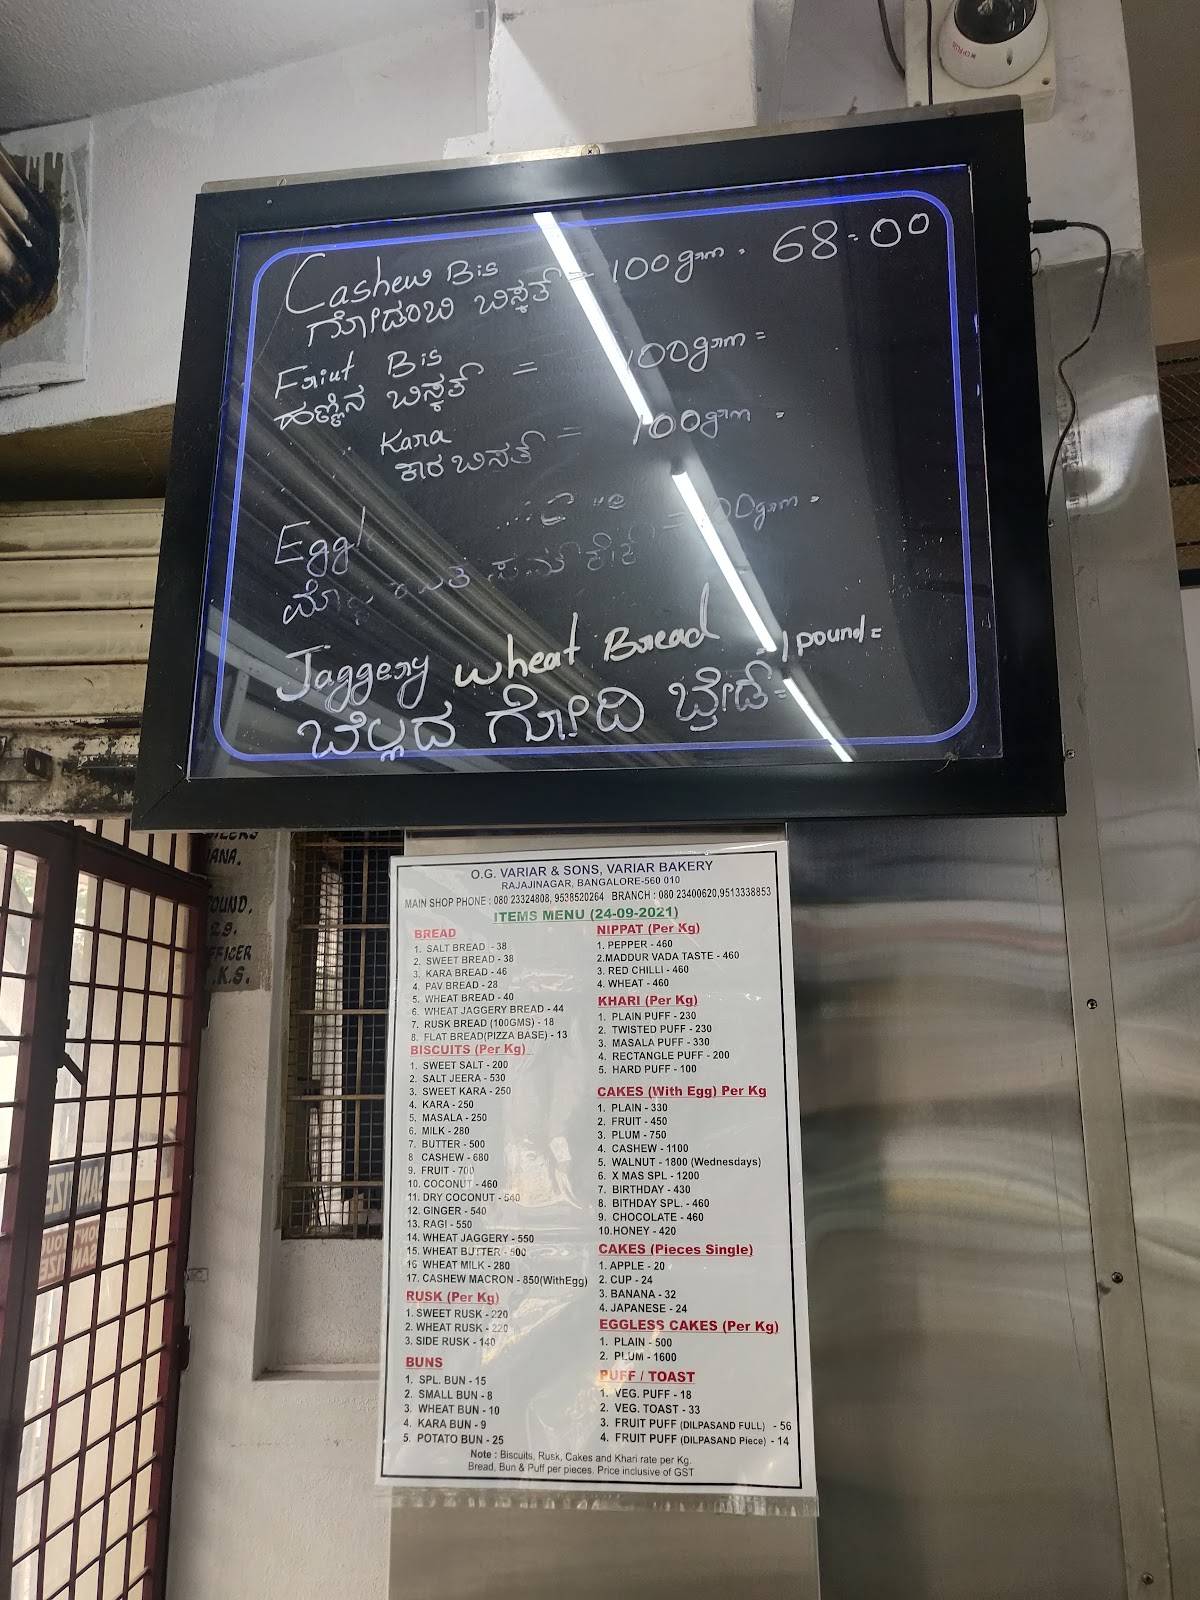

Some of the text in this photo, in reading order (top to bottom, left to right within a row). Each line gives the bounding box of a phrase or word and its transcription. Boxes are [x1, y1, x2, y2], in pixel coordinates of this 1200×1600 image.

[285, 253, 432, 314] Cashew
[447, 260, 498, 285] Bis
[387, 349, 442, 378] Bis
[380, 429, 452, 455] Kara
[604, 583, 720, 662] Bread
[207, 848, 241, 865] ANA.
[471, 861, 713, 880] O.G. VARIAR & SONS, VARIAR BAKERY
[501, 876, 680, 890] RAJAJINAGAR, BANGALORE-560 010
[405, 899, 427, 908] MAIN
[430, 898, 453, 907] SHOP
[456, 897, 487, 906] PHONE
[494, 896, 508, 905] 080
[511, 894, 551, 904] 23324808,
[555, 892, 604, 903] 9538520264
[612, 891, 651, 900] BRANCH
[658, 890, 674, 899] 080
[494, 907, 678, 922] ITEMS MENU (24-09-2021)
[414, 929, 456, 939] BREAD
[597, 923, 700, 935] NIPPAT (Per Kg)
[427, 942, 507, 953] SALT BREAD 38
[608, 941, 648, 949] PEPPER
[426, 955, 514, 965] SWEET BREAD 38
[426, 968, 507, 978] KARA BREAD 46
[608, 966, 628, 975] RED
[632, 966, 664, 974] CHILLI
[425, 982, 443, 990] PAV
[446, 981, 478, 989] BREAD
[425, 993, 514, 1003] WHEAT BREAD 40
[598, 995, 697, 1007] KHARI (Per Kg)
[425, 1007, 458, 1016] WHEAT
[460, 1006, 507, 1015] JAGGERY
[510, 1005, 544, 1013] BREAD
[612, 1025, 656, 1034] TWISTED
[660, 1025, 686, 1033] PUFF
[410, 1044, 526, 1055] BISCUITS (Per Kg)
[422, 1061, 508, 1070] SWEET SALT 200
[422, 1074, 506, 1083] SALT JEERA 530
[598, 1085, 767, 1098] CAKES (With Egg) Per Kg
[611, 1103, 668, 1112] PLAIN 330
[422, 1113, 487, 1122] MASALA 250
[422, 1127, 470, 1135] MILK 280
[422, 1140, 485, 1148] BUTTER 500
[422, 1153, 489, 1162] CASHEW 680
[612, 1156, 762, 1168] WALNUT 1800 (Wednesdays)
[612, 1185, 691, 1194] BIRTHDAY 430
[612, 1213, 704, 1221] CHOCOLATE 460
[423, 1234, 534, 1243] WHEAT JAGGERY 550
[599, 1243, 753, 1257] CAKES (Pieces Single)
[406, 1291, 500, 1305] RUSK (Per Kg)
[610, 1289, 676, 1299] BANANA 32
[610, 1303, 687, 1313] JAPANESE 24
[600, 1319, 779, 1334] EGGLESS CAKES (Per Kg)
[406, 1357, 443, 1368] BUNS
[650, 1371, 695, 1382] TOAST
[418, 1389, 454, 1399] SMALL
[456, 1390, 478, 1400] BUN
[615, 1403, 700, 1414] VEG. TOAST 33
[418, 1419, 447, 1429] KARA
[449, 1419, 472, 1429] BUN
[615, 1418, 792, 1431] FRUIT PUFF (DILPASAND FULL) 56
[499, 1462, 517, 1471] Bun
[519, 1463, 525, 1472] &
[527, 1463, 545, 1473] Puff
